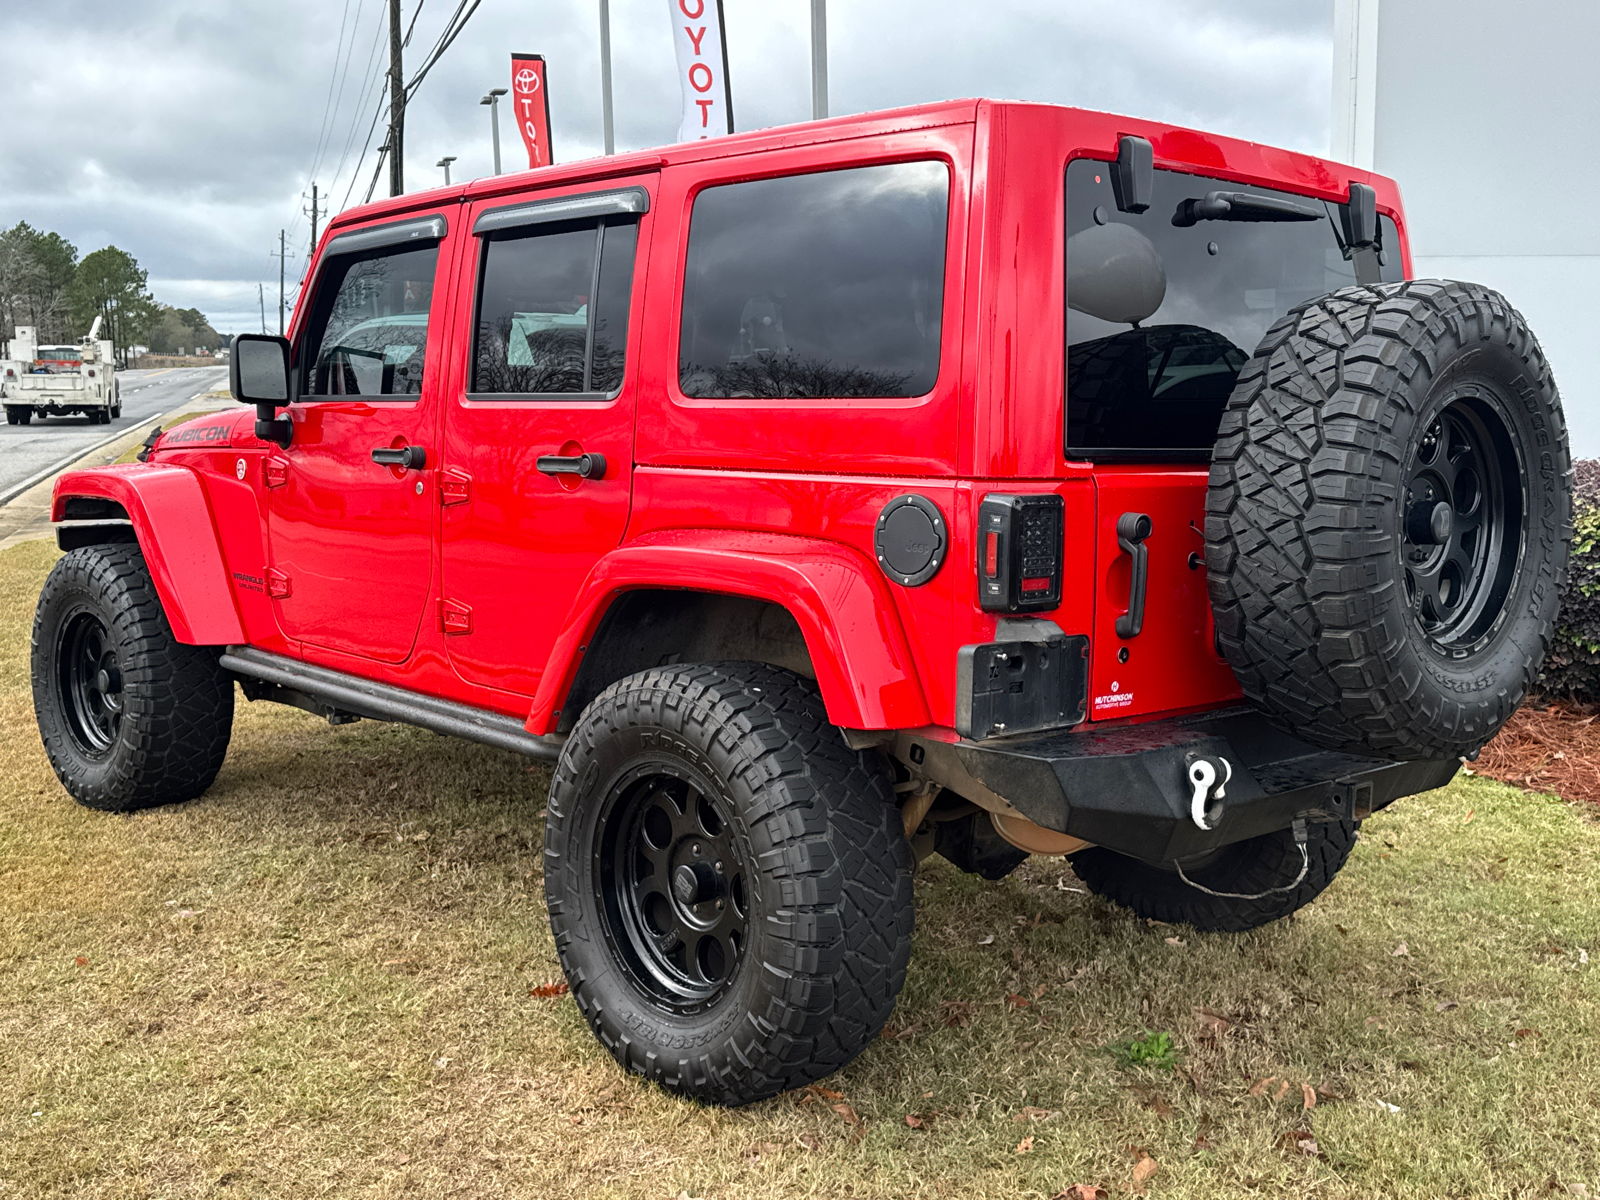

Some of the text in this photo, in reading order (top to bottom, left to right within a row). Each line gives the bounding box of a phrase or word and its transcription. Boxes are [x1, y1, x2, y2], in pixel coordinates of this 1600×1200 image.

[679, 0, 713, 139] OYOT
[166, 426, 231, 443] RUBICON
[905, 540, 930, 555] Jeep
[1095, 692, 1134, 704] HUTCHINSON
[640, 730, 699, 764] RIDGE
